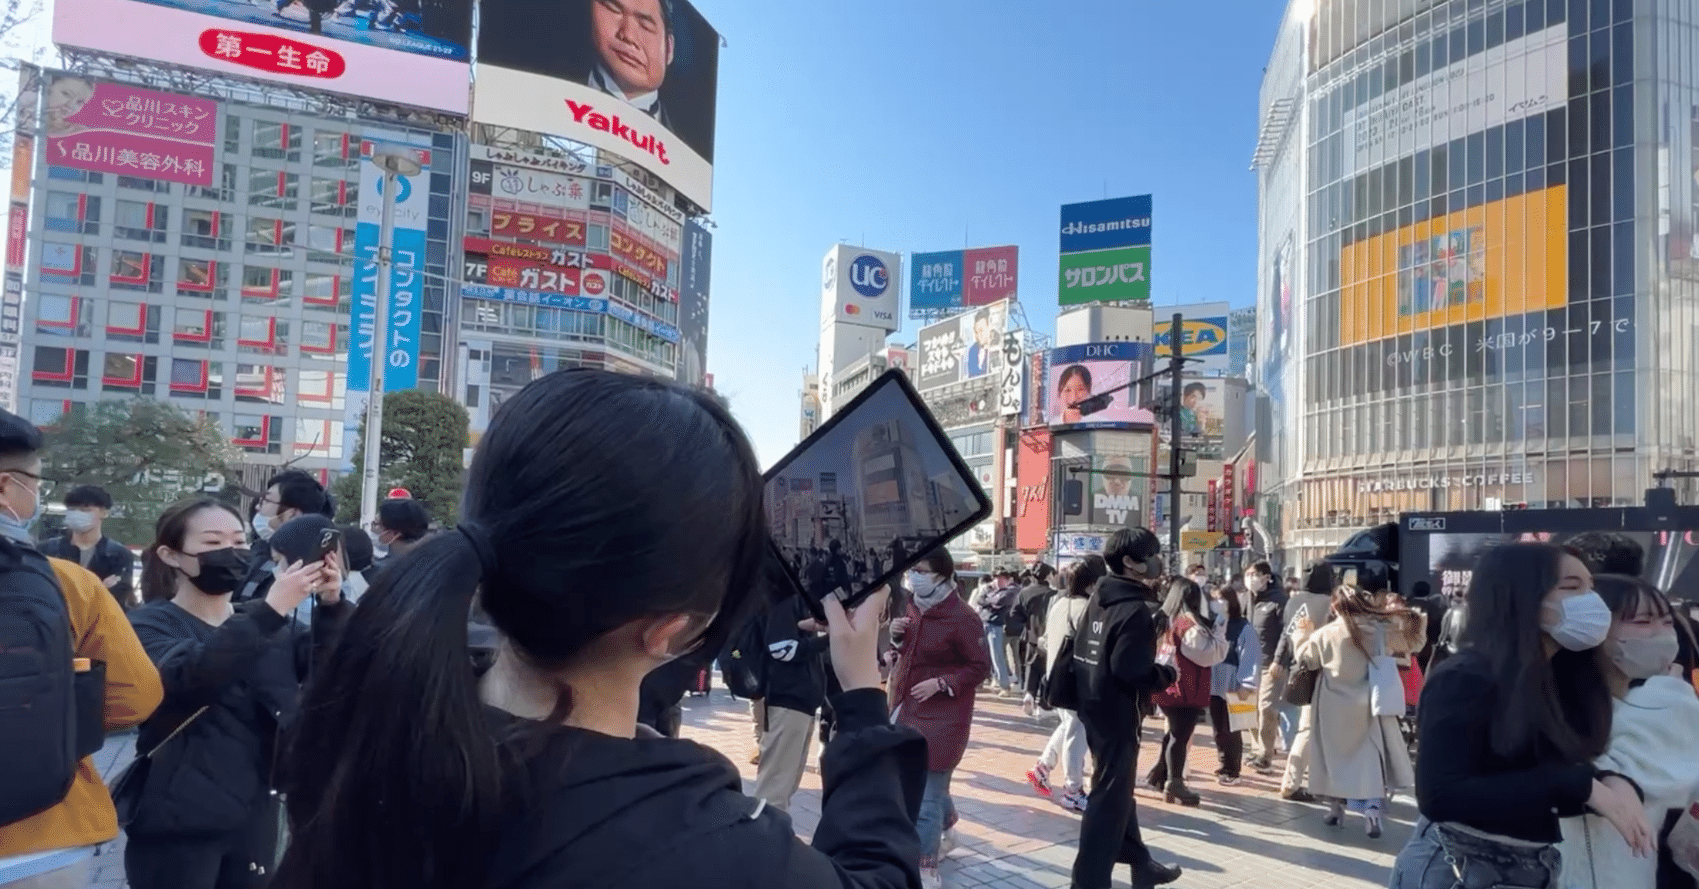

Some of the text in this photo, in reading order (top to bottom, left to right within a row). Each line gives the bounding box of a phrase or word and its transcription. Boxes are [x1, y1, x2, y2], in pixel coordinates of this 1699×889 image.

[214, 33, 332, 75] 第一生命
[126, 95, 210, 120] 品川スキン
[127, 112, 199, 135] クリニック
[564, 98, 671, 166] Yakult
[71, 142, 206, 178] 品川美容外科
[486, 148, 587, 173] しゃぶしゃぶバイキング
[471, 171, 491, 184] 9F
[527, 176, 583, 200] しゃぶ葉
[1062, 218, 1150, 235] Hisamitsu
[466, 263, 488, 277] 7F
[550, 249, 594, 268] ガスト
[520, 268, 576, 292] ガスト
[853, 263, 887, 289] UC
[1065, 262, 1145, 288] サロンパス
[389, 249, 415, 368] コンタクトの
[874, 311, 893, 320] VISA
[1154, 329, 1218, 346] KEA
[1086, 344, 1118, 357] DHC
[1002, 331, 1022, 411] もんじゃ
[1359, 472, 1533, 493] STARBUCKS COFFEE
[1094, 494, 1139, 511] DMM
[1106, 509, 1128, 524] TV
